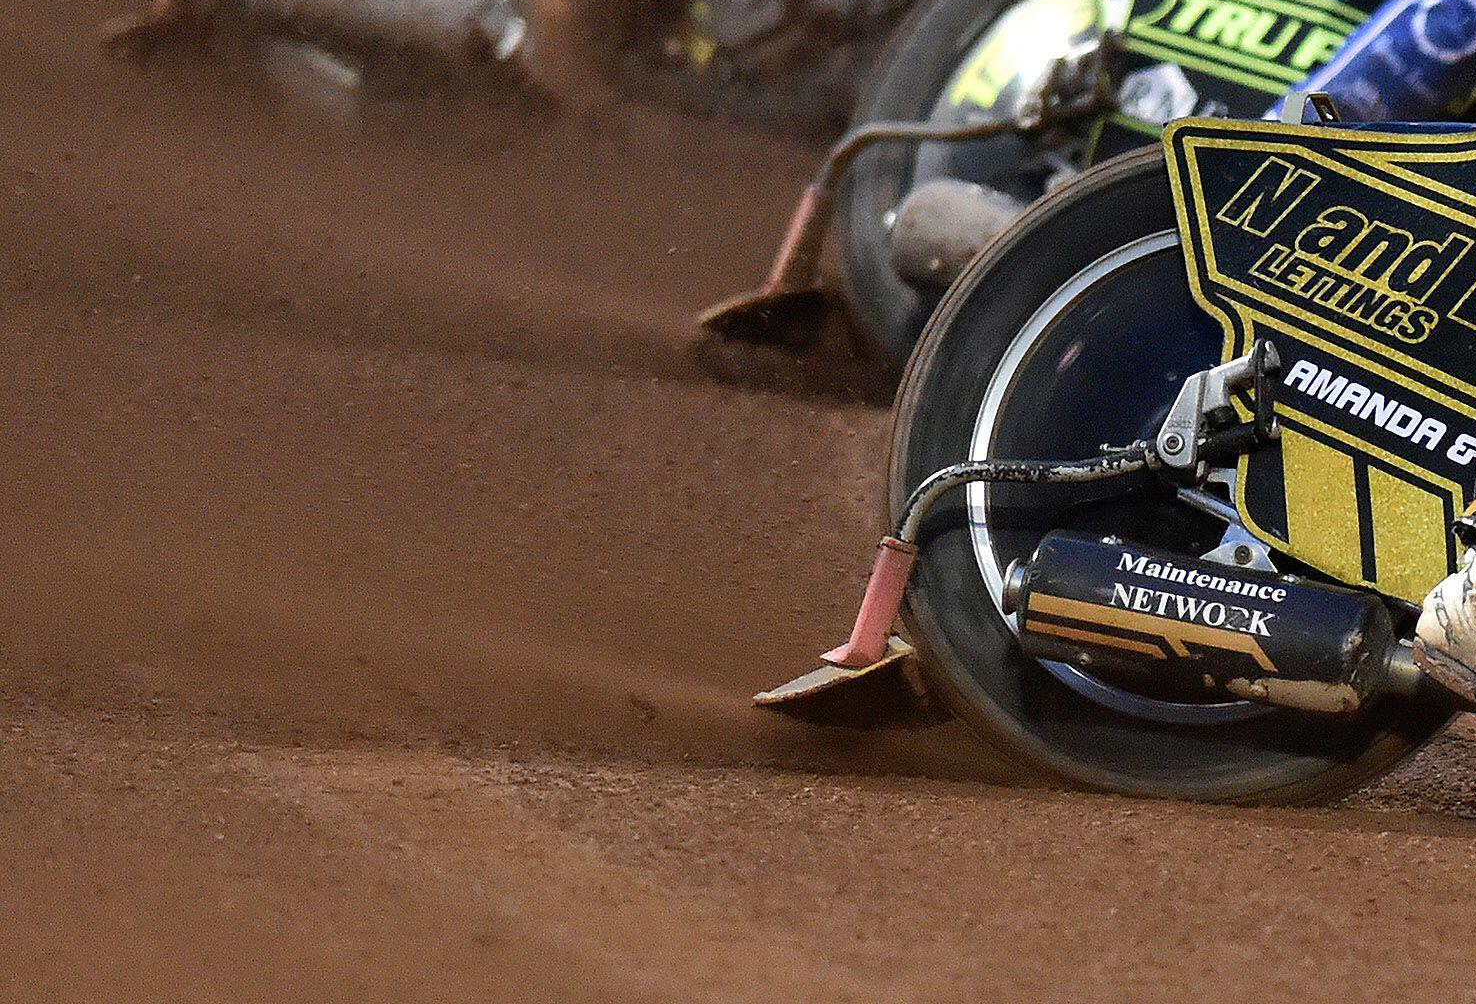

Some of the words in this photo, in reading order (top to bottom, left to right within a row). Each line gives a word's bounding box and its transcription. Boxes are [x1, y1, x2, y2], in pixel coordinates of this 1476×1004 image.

[1215, 157, 1321, 237] N
[1297, 204, 1475, 307] and
[1248, 244, 1441, 346] LETTINGS
[1283, 358, 1448, 451] AMANDA
[1115, 551, 1289, 605] Maintenance
